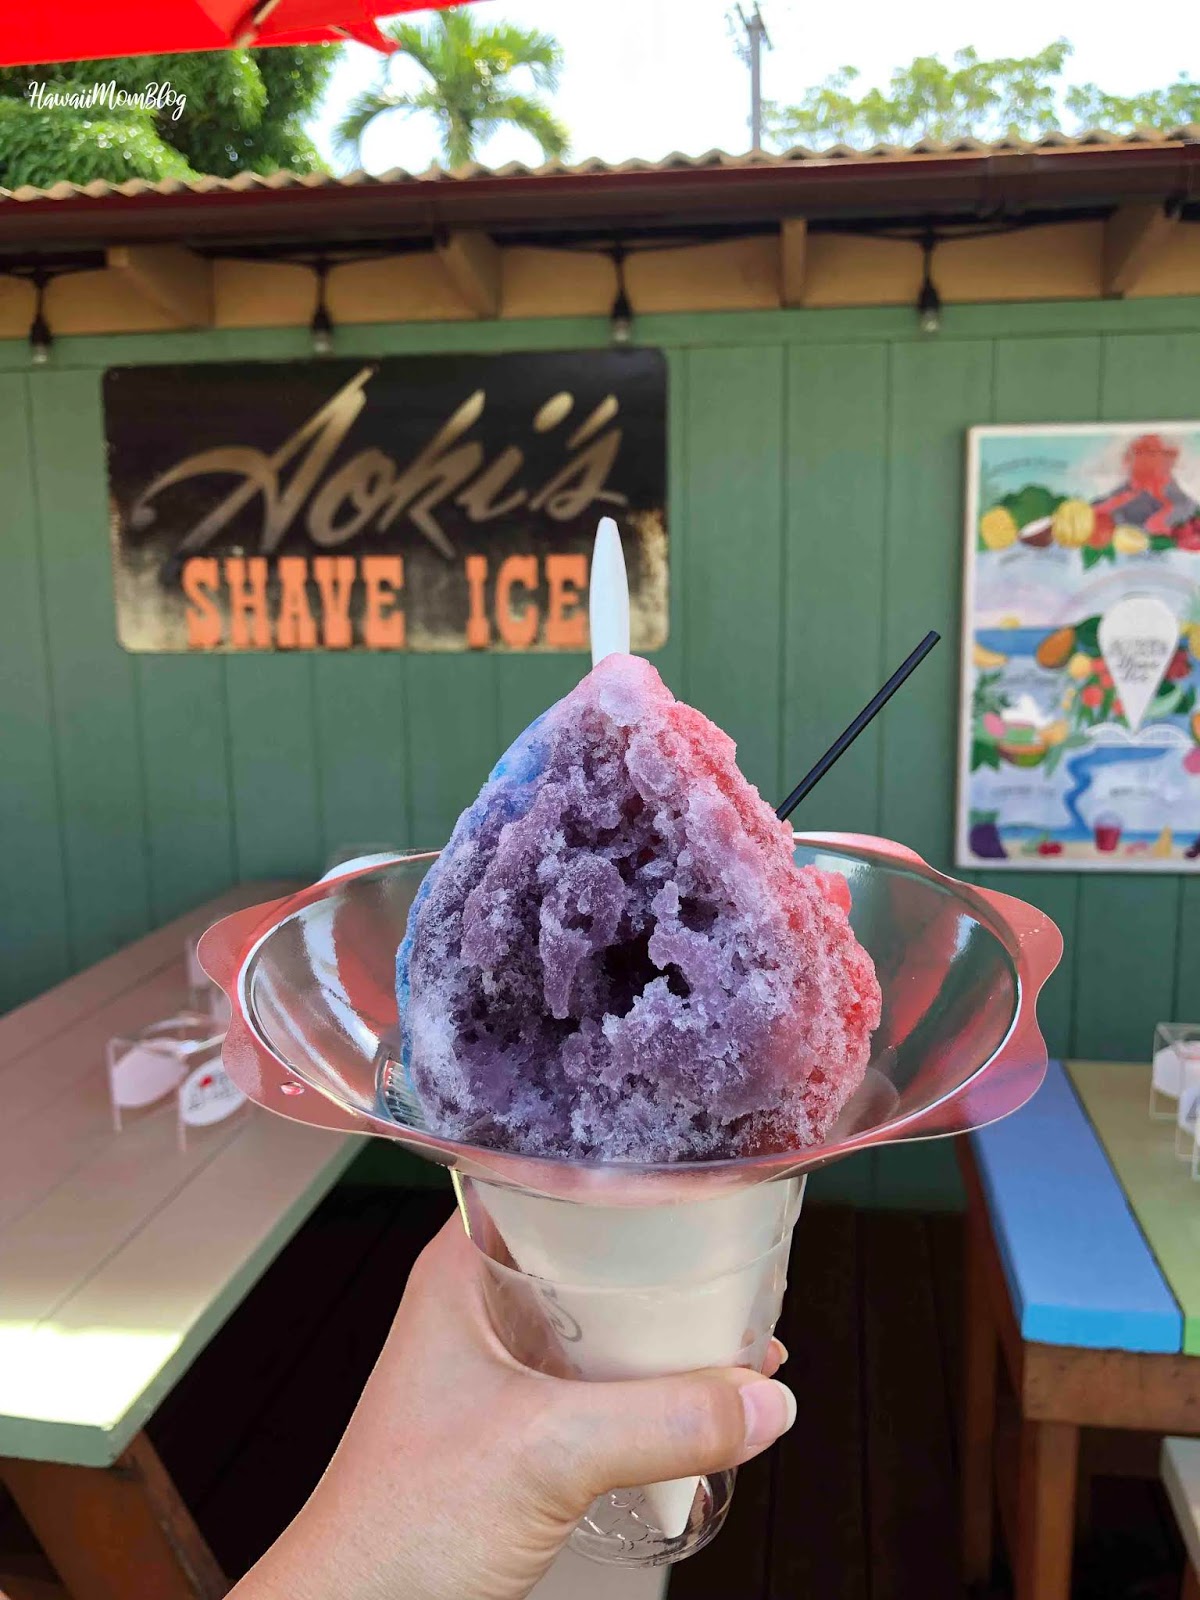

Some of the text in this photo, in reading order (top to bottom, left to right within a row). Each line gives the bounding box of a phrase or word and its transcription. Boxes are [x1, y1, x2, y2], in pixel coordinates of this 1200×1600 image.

[130, 366, 628, 560] Aoki's
[182, 553, 589, 649] SHAVE ICE
